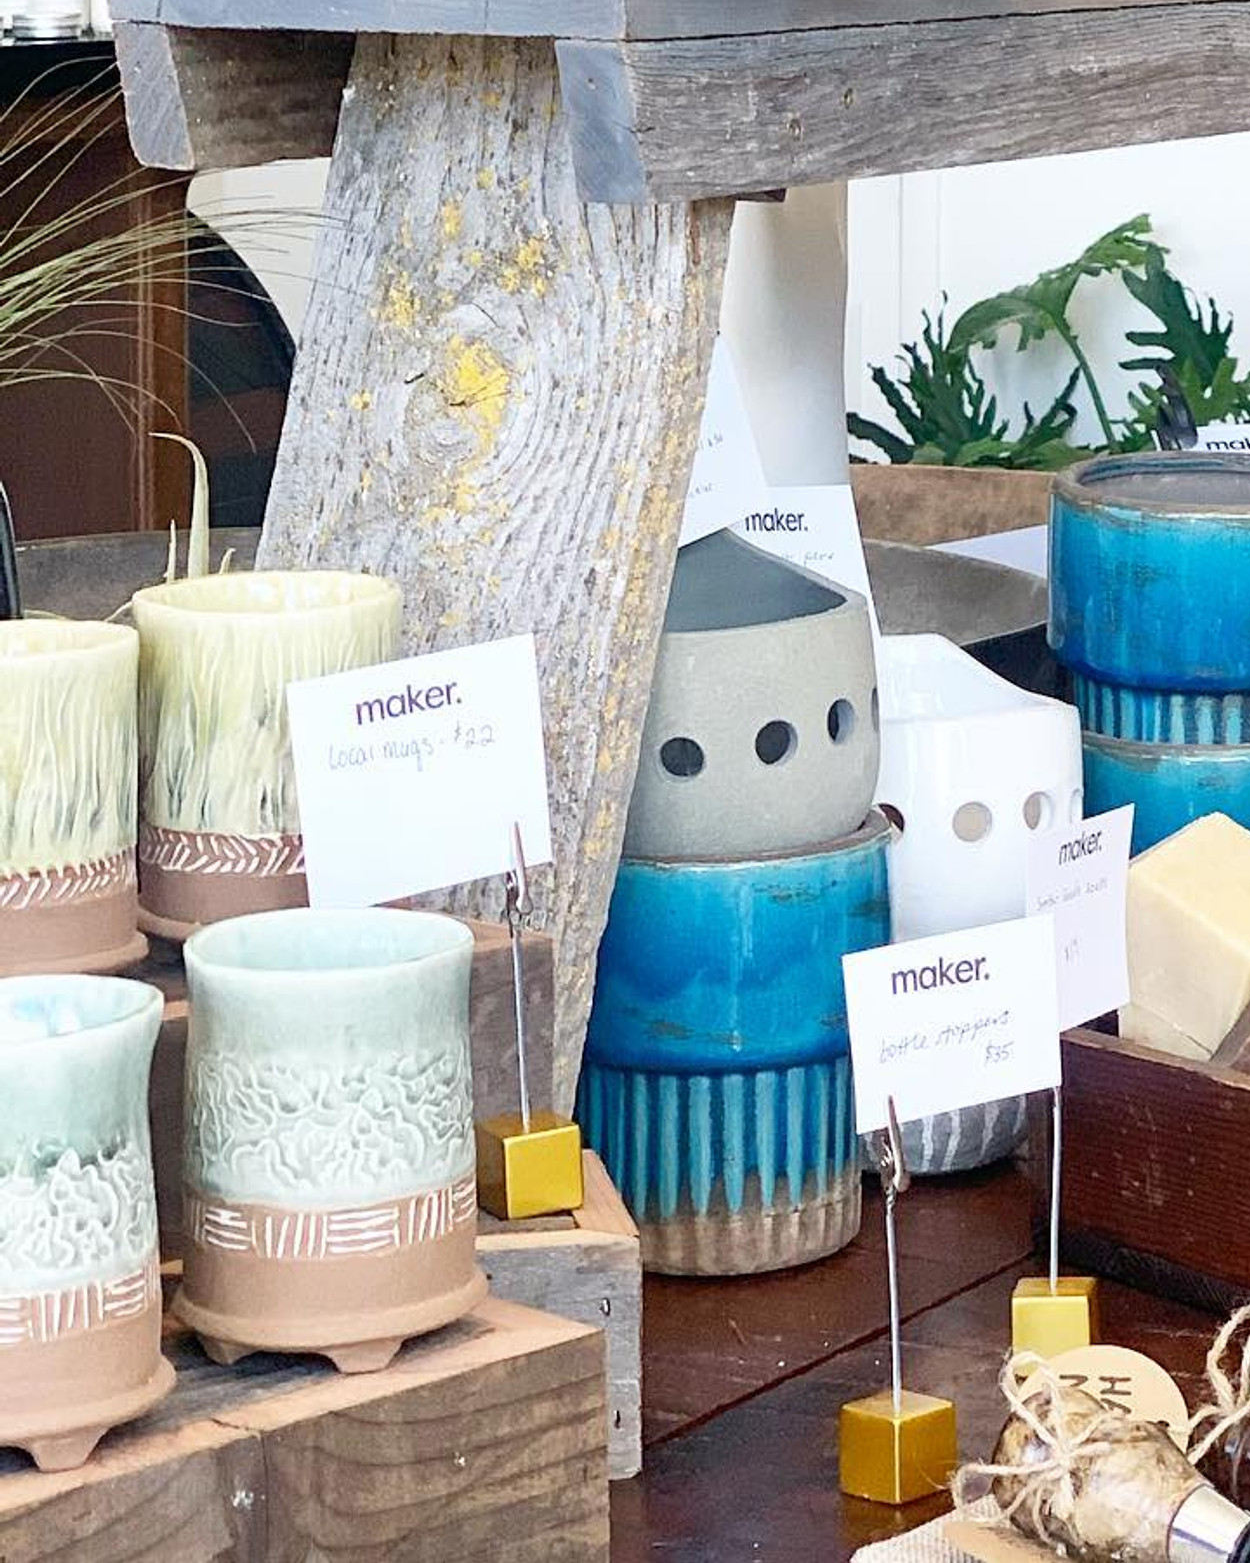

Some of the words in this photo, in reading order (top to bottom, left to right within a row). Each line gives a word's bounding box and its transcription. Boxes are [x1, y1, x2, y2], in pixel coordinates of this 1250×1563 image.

[745, 507, 809, 532] maker.
[355, 681, 462, 726] maker.
[1057, 829, 1103, 866] maker.
[891, 956, 990, 995] maker.
